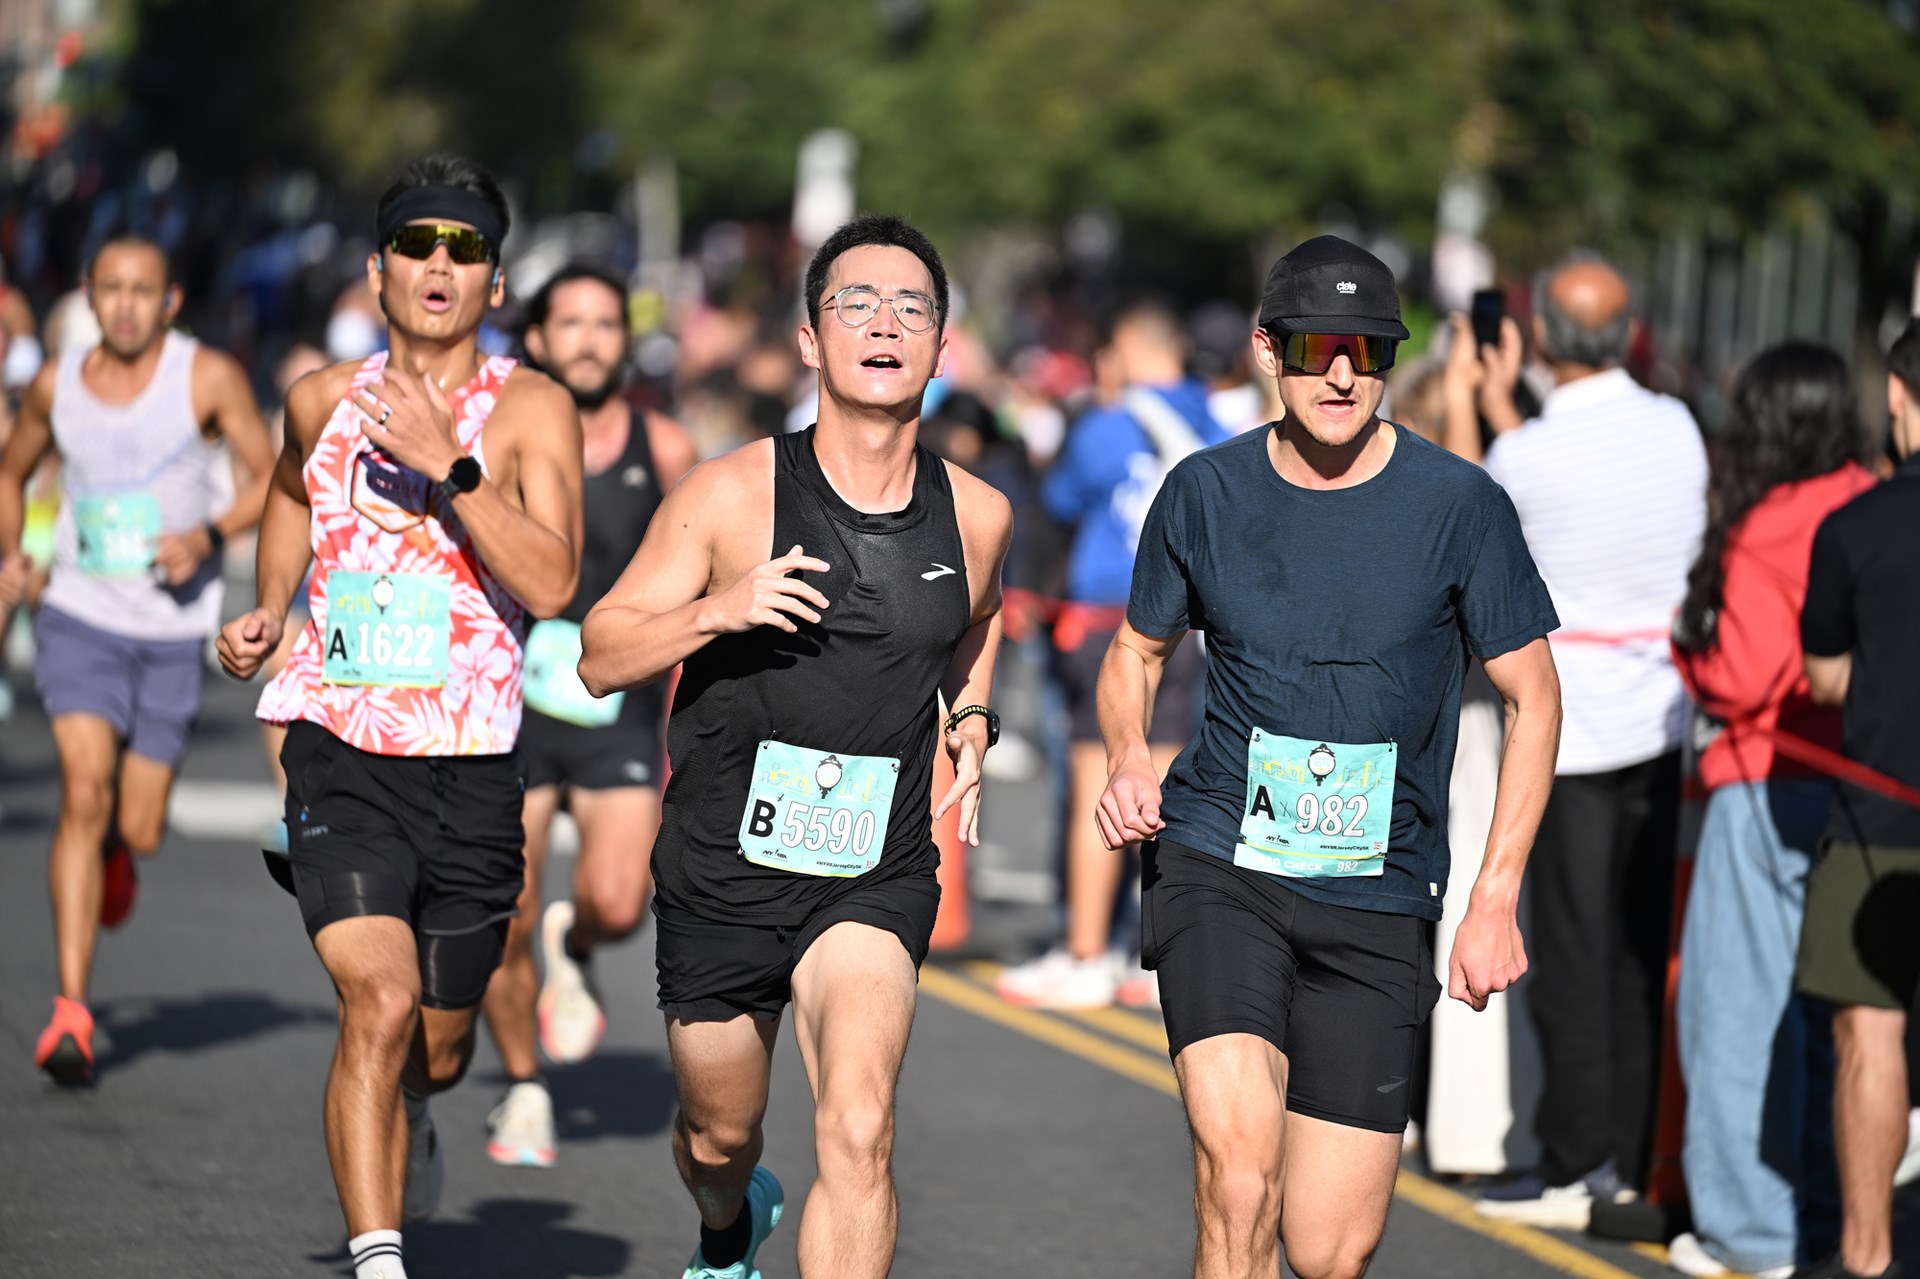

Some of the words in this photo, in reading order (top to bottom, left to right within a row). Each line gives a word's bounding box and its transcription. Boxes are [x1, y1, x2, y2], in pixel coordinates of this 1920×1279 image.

[1336, 281, 1357, 291] ciele
[328, 628, 348, 661] A
[356, 622, 435, 667] 1622
[748, 798, 777, 838] B
[780, 801, 876, 857] 5590
[1250, 784, 1276, 822] A
[1295, 792, 1369, 838] 982
[1284, 860, 1323, 872] CHECK
[1336, 860, 1359, 873] 982
